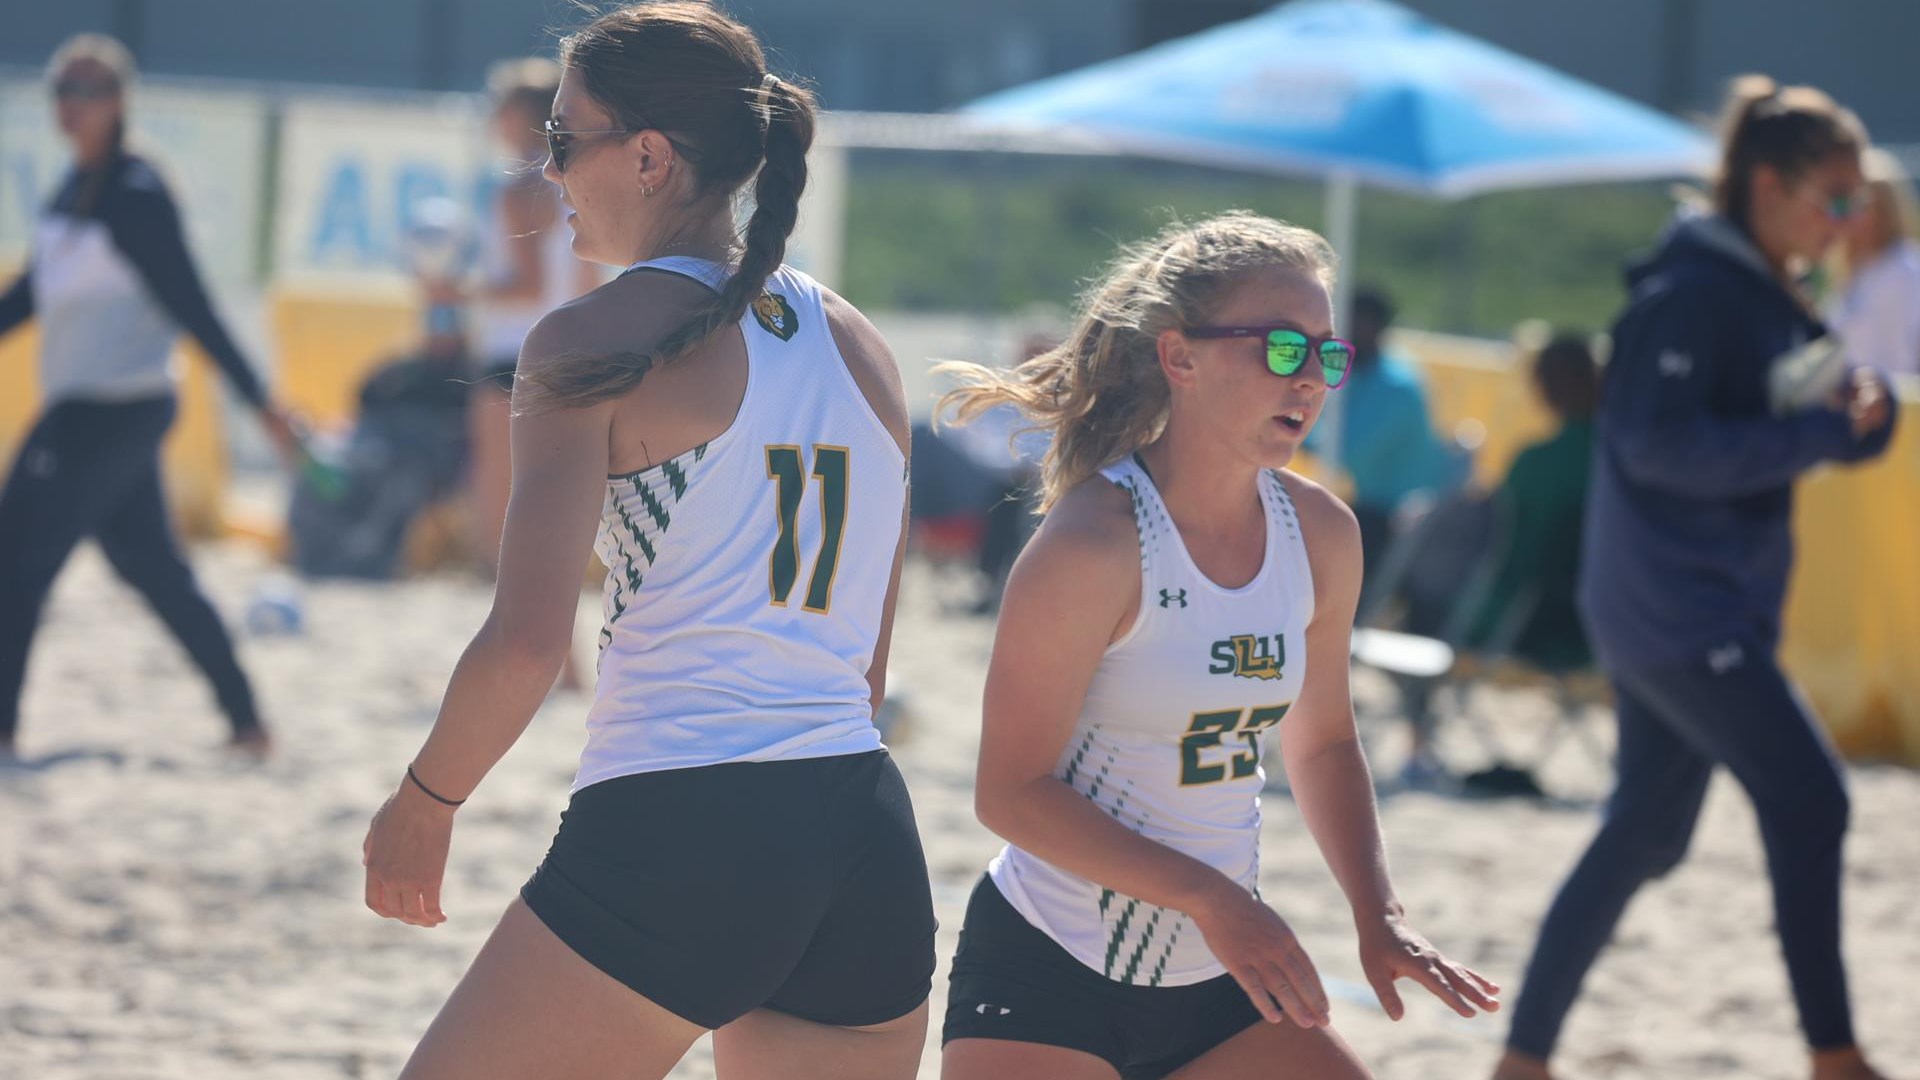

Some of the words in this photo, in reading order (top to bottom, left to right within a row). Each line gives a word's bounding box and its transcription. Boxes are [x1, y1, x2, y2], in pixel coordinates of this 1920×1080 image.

[764, 443, 850, 615] 11
[1209, 634, 1285, 679] SLU
[1178, 701, 1292, 787] 23
